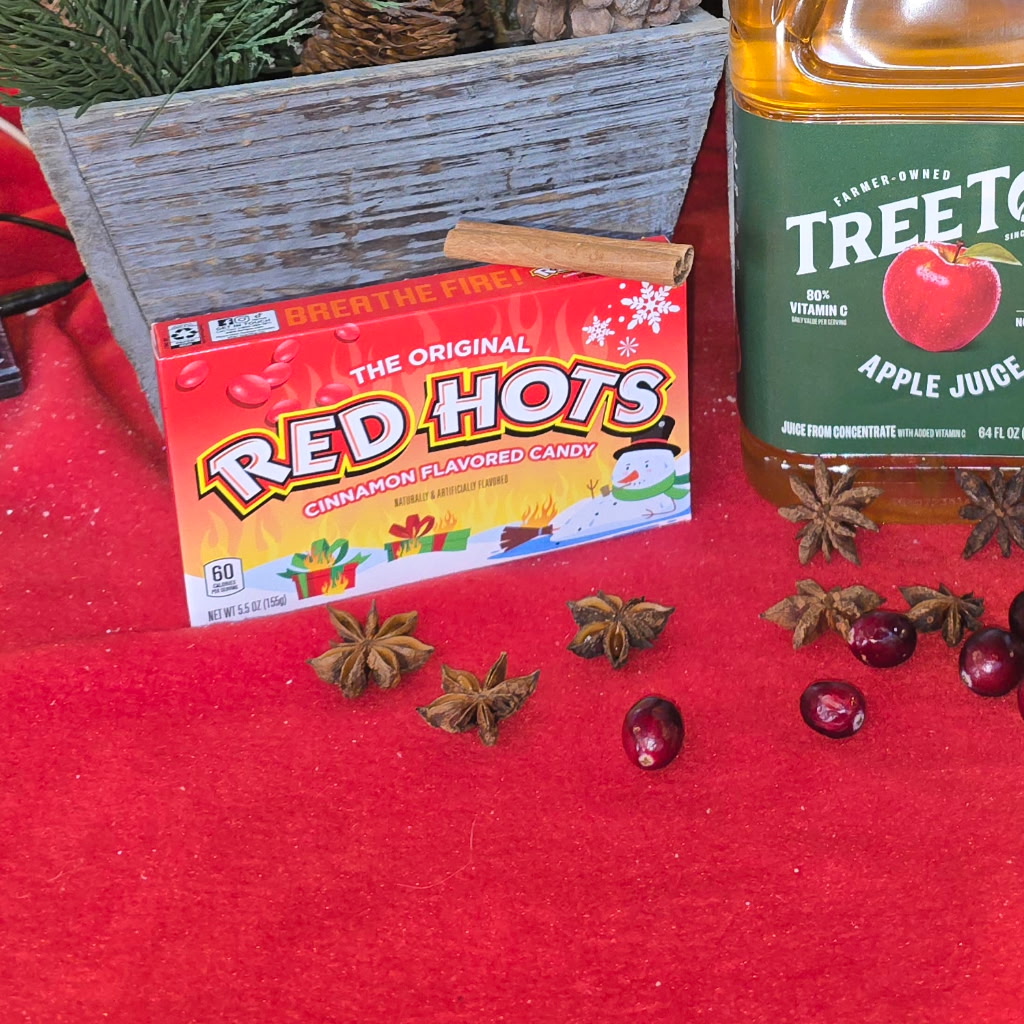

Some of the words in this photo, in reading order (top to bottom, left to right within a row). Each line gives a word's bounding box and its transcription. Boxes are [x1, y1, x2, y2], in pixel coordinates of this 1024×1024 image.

[832, 168, 951, 207] FARMER-OWNED
[284, 282, 437, 328] BREATHE
[441, 268, 524, 298] FIRE!
[806, 289, 830, 301] 80%
[790, 301, 837, 316] VITAMIN
[839, 305, 848, 317] C
[350, 354, 402, 385] THE
[408, 335, 531, 367] ORIGINAL
[857, 354, 940, 398] APPLE
[203, 394, 411, 508] RED
[422, 359, 668, 442] HOTS
[781, 420, 806, 437] JUICE
[807, 424, 832, 439] FROM
[833, 425, 897, 439] CONCENTRATE
[897, 428, 913, 438] WITH
[914, 428, 934, 438] ADDED
[935, 428, 961, 438] VITAMIN
[961, 429, 966, 438] C
[978, 426, 993, 439] 64
[994, 427, 1005, 439] FL
[1006, 426, 1020, 439] OZ
[303, 468, 415, 517] CINNAMON
[421, 447, 524, 483] FLAVORED
[529, 442, 597, 461] CANDY
[394, 491, 429, 507] NATURALLY
[430, 489, 436, 499] &
[212, 563, 234, 582] 60
[208, 609, 222, 621] NET
[223, 605, 236, 618] WT
[238, 604, 250, 615] 5.5
[251, 600, 261, 611] OZ
[263, 594, 287, 610] (155g)
